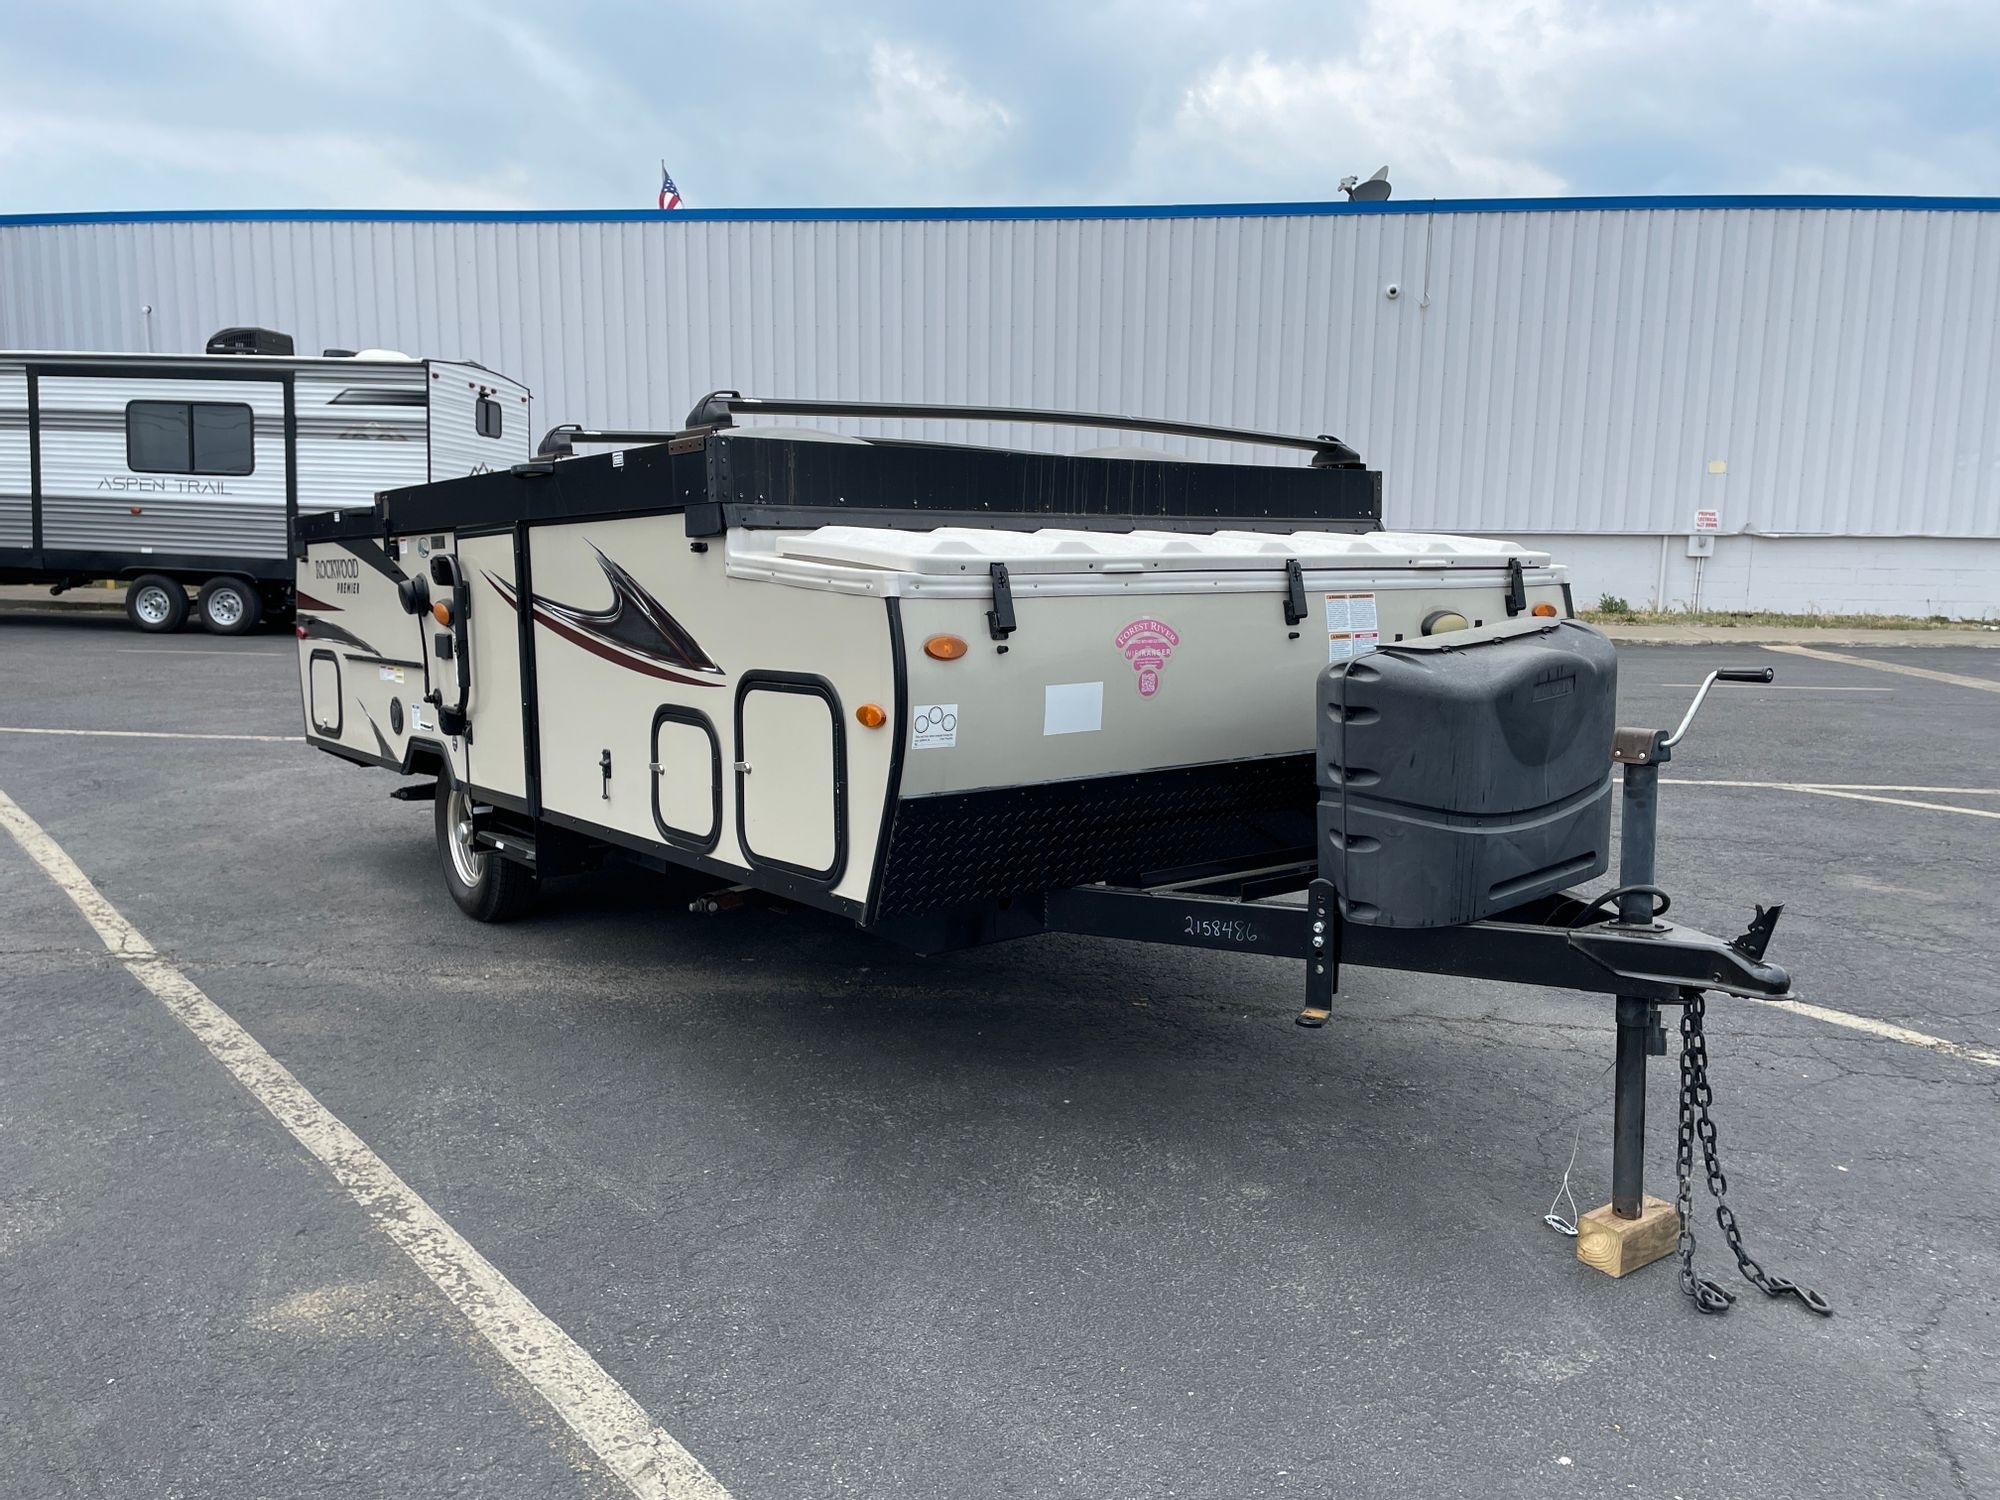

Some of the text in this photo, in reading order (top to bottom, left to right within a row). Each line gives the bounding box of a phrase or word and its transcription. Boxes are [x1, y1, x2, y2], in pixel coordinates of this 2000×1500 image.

[97, 476, 233, 495] ASPEN TRAIL
[315, 558, 359, 579] ROCKWOOD
[336, 582, 360, 594] PREMIER
[1118, 621, 1176, 645] FOREST RIVER
[1184, 915, 1258, 942] 2158486
